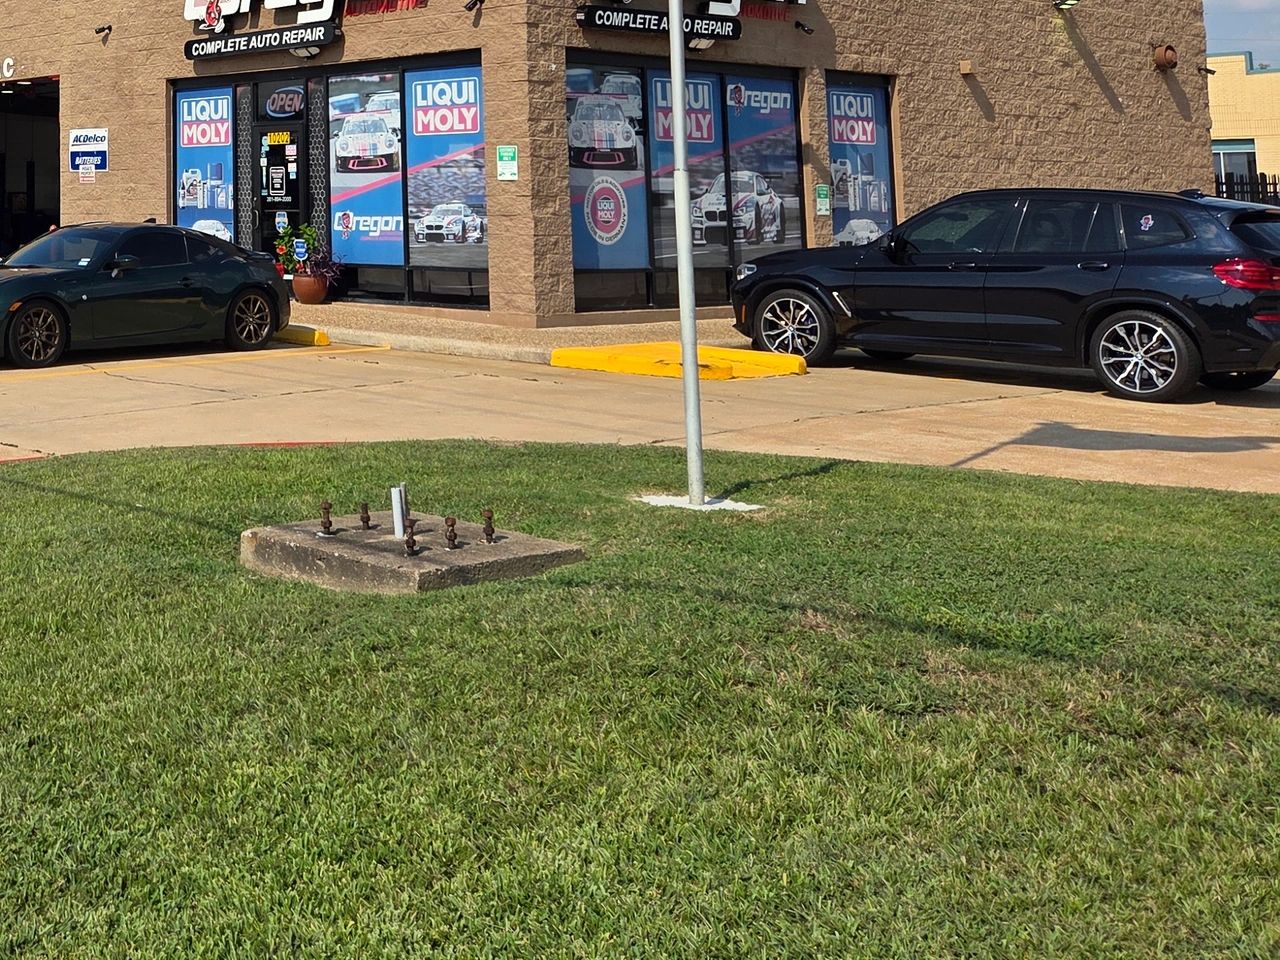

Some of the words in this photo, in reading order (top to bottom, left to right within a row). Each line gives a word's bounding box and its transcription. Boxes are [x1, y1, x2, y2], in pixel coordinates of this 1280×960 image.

[595, 10, 659, 30] COMPLETE
[660, 16, 692, 33] AO
[694, 19, 733, 36] REPAIR
[192, 35, 248, 57] COMPLETE
[250, 32, 280, 51] AUTO
[283, 26, 325, 45] REPAIR
[269, 93, 303, 112] OPEN
[416, 80, 475, 106] LIQUI
[656, 82, 710, 109] LIUI
[726, 84, 791, 114] Oregon
[183, 99, 228, 121] LIQUI
[833, 95, 872, 118] LIQUI
[417, 107, 477, 132] MOLY
[657, 112, 712, 139] MLY
[834, 119, 874, 142] MOLY
[72, 133, 106, 143] ACDelco
[183, 122, 229, 144] MOLY
[268, 132, 289, 144] 10202
[334, 211, 403, 237] Oregon
